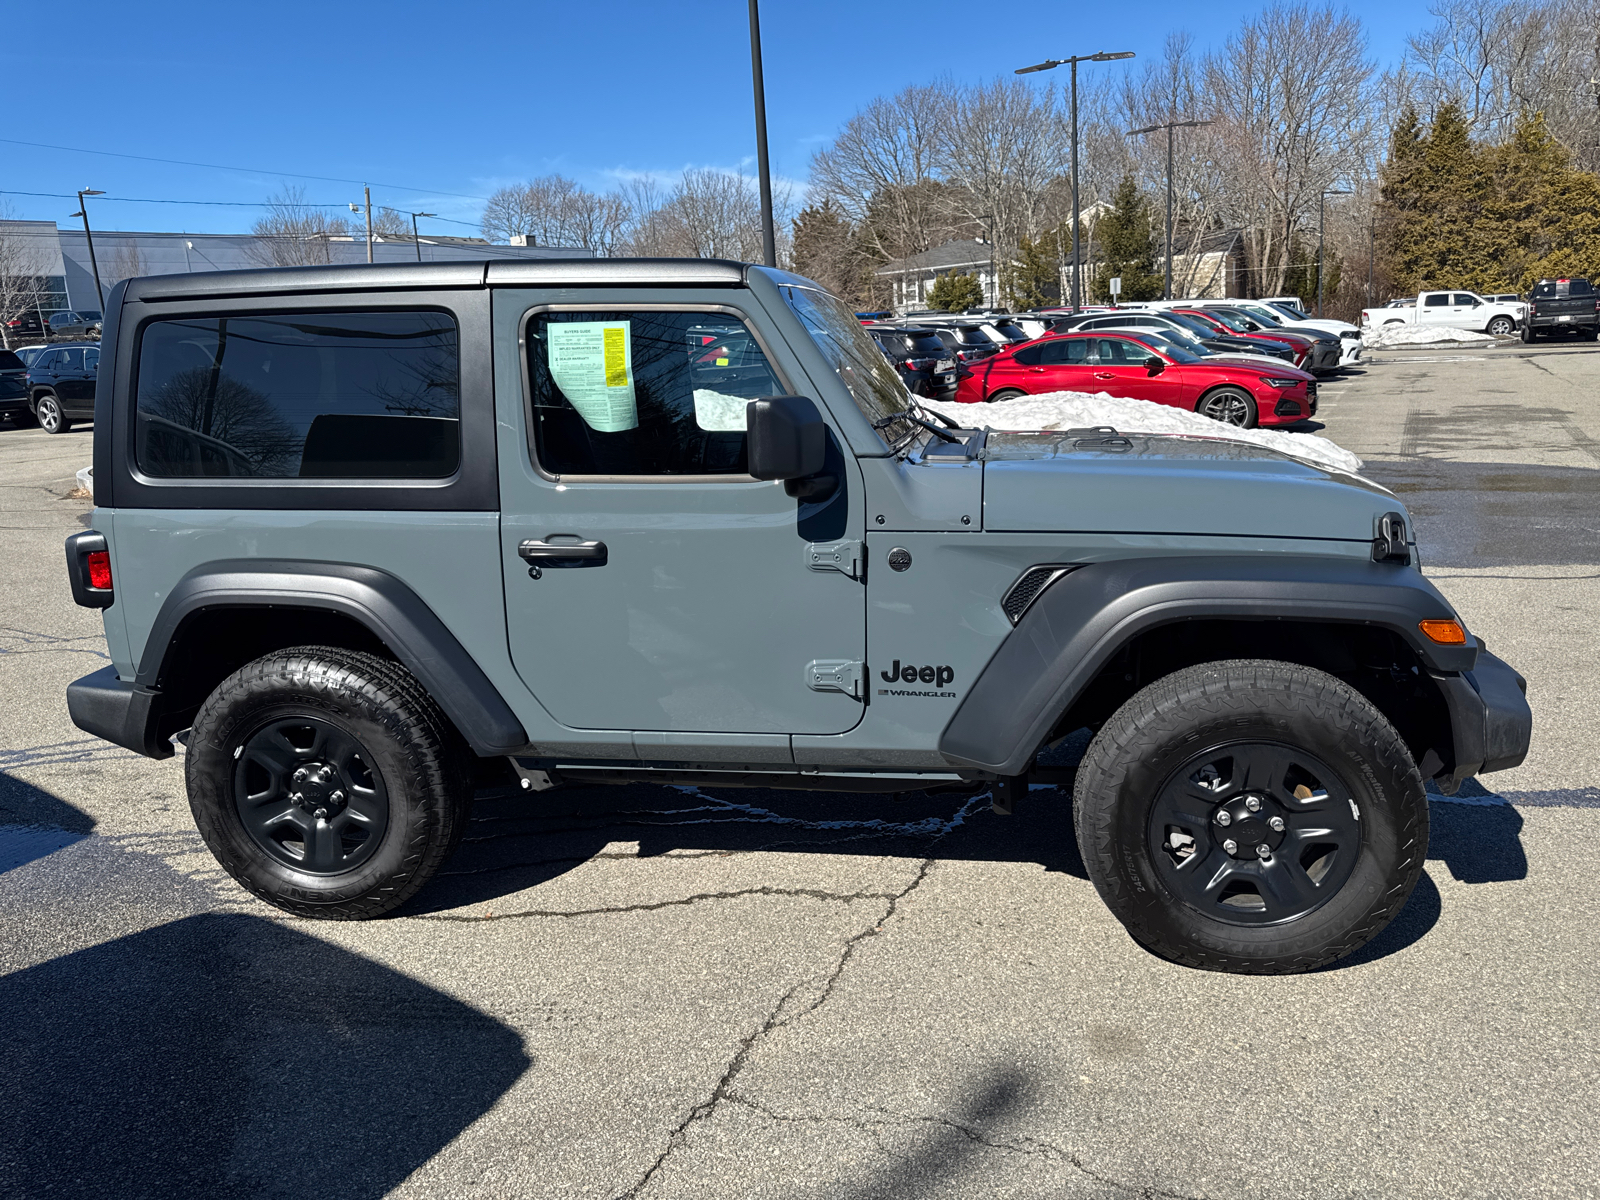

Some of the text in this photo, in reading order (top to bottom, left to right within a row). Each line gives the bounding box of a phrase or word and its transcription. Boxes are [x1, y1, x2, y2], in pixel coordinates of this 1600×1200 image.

[880, 659, 954, 688] Jeep
[889, 689, 957, 698] WRANGLER
[1156, 715, 1276, 760] NEXEN
[1346, 749, 1388, 802] All-Weather
[1121, 843, 1147, 893] 245/75R17
